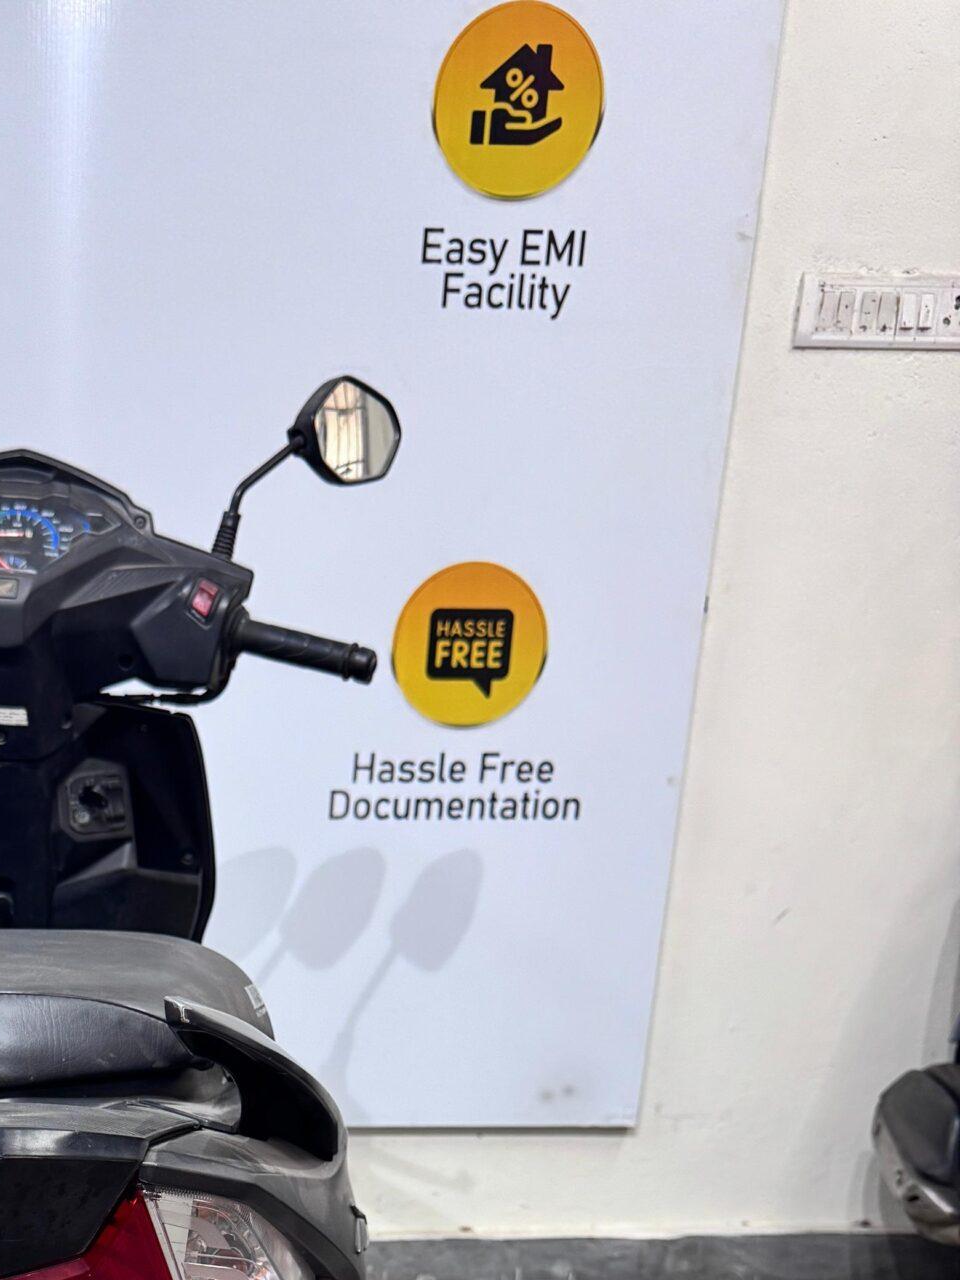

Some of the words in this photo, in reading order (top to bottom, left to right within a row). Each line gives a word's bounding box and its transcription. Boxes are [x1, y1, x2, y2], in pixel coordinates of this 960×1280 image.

[421, 227, 509, 276] Easy
[520, 229, 587, 267] EMI
[441, 272, 571, 321] Facility
[436, 619, 507, 638] HASSLE
[434, 640, 504, 669] FREE
[352, 752, 467, 785] Hassle
[479, 751, 555, 784] Free
[328, 789, 582, 822] Documentation
